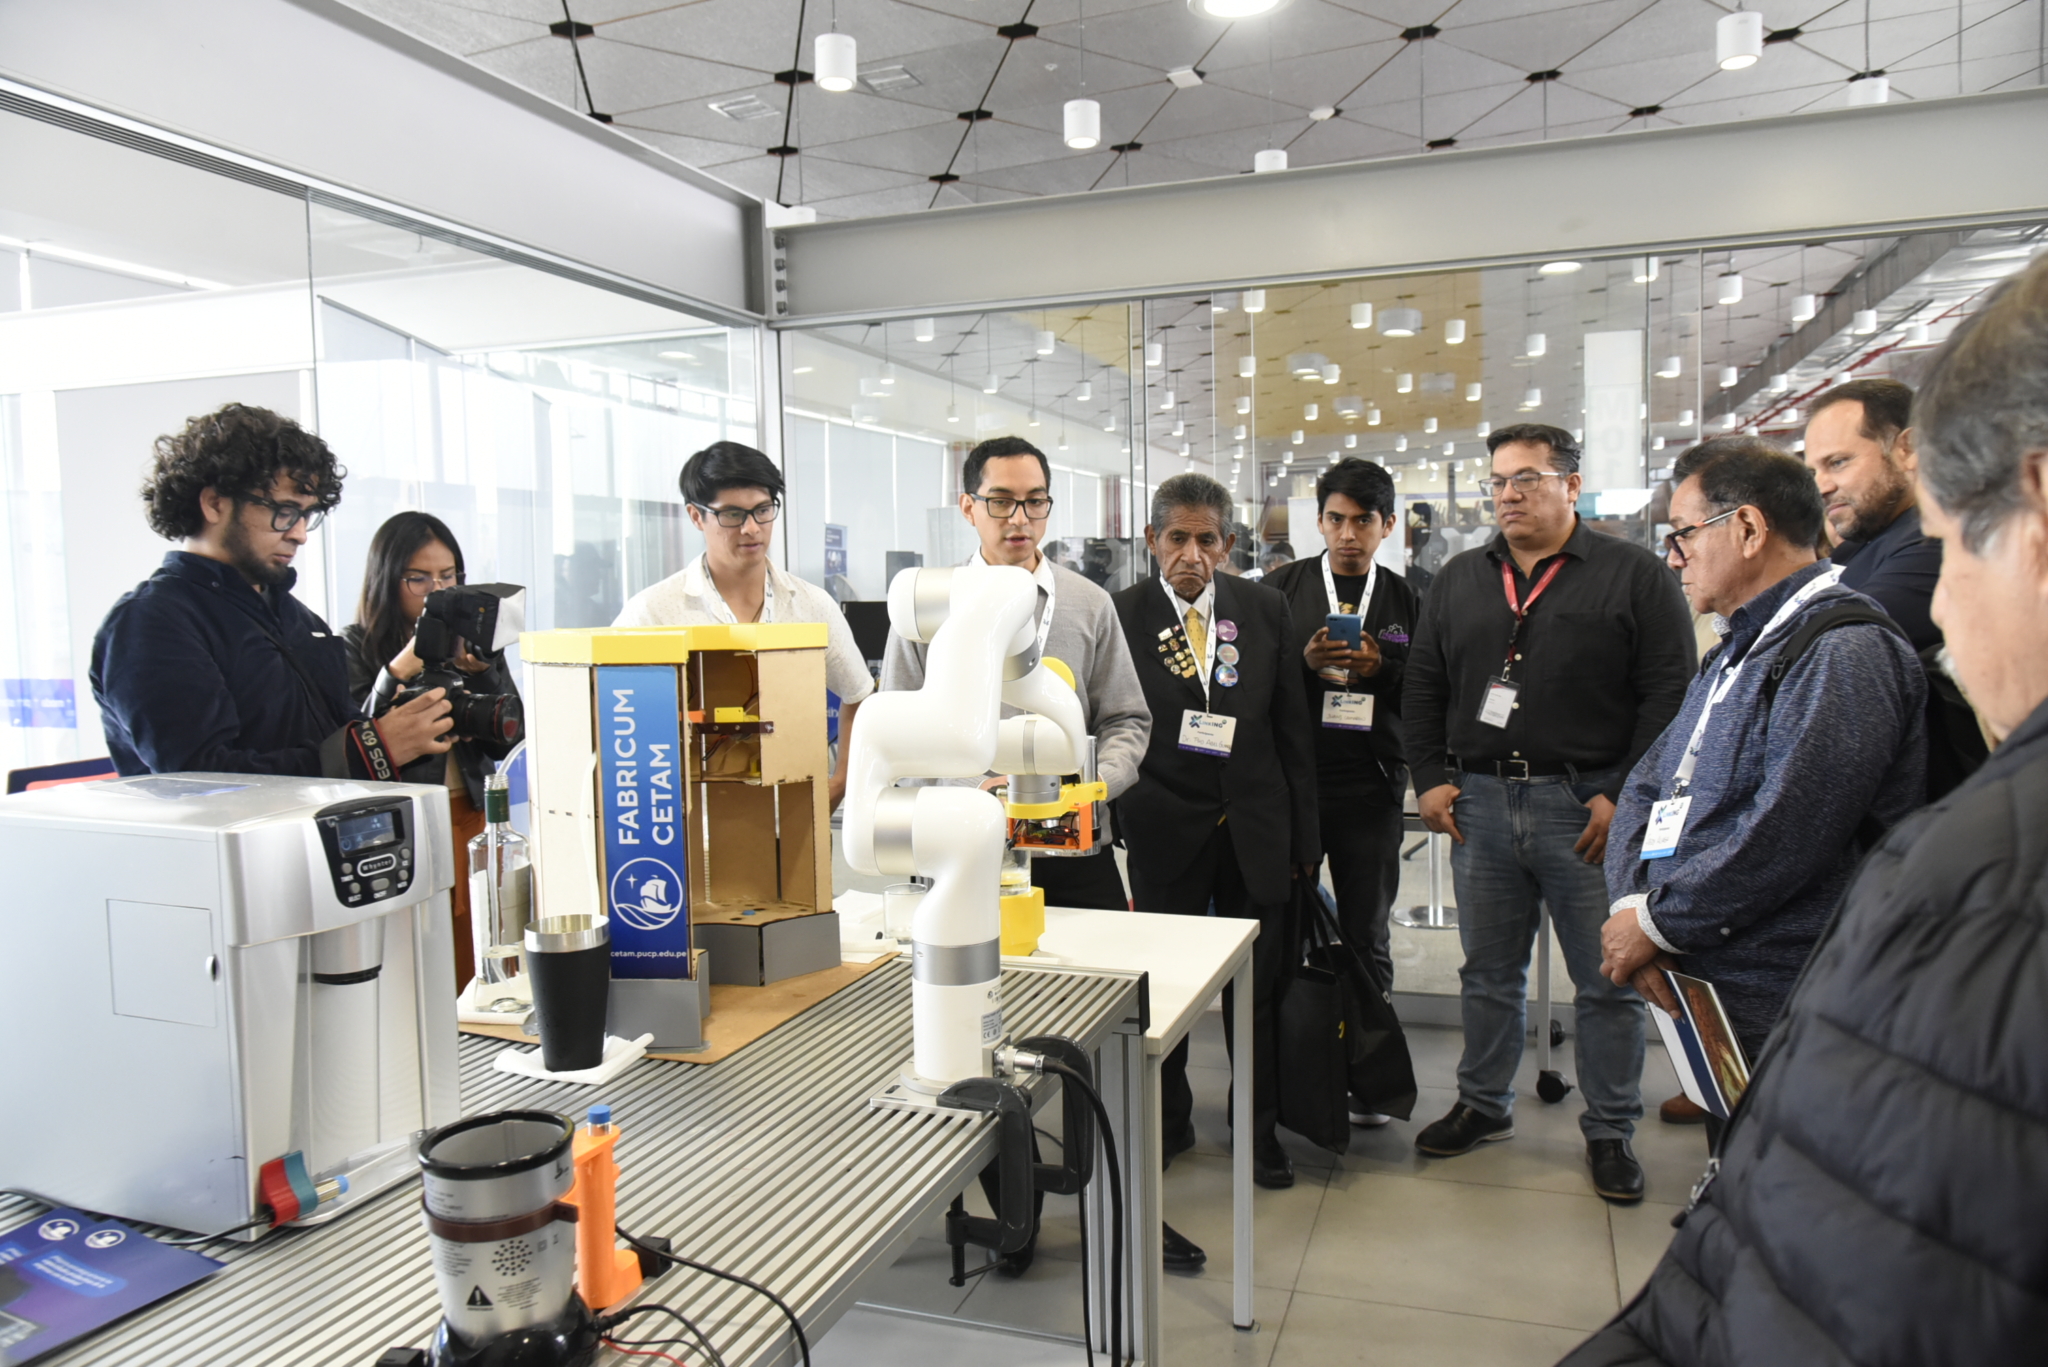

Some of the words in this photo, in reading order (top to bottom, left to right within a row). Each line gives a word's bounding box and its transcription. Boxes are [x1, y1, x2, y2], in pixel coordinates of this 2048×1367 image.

[361, 730, 378, 746] 6D
[369, 747, 391, 780] EOS
[612, 689, 640, 845] FABRICUM
[649, 743, 675, 845] CETAM
[610, 950, 687, 959] cetam.pucp.edu.pe
